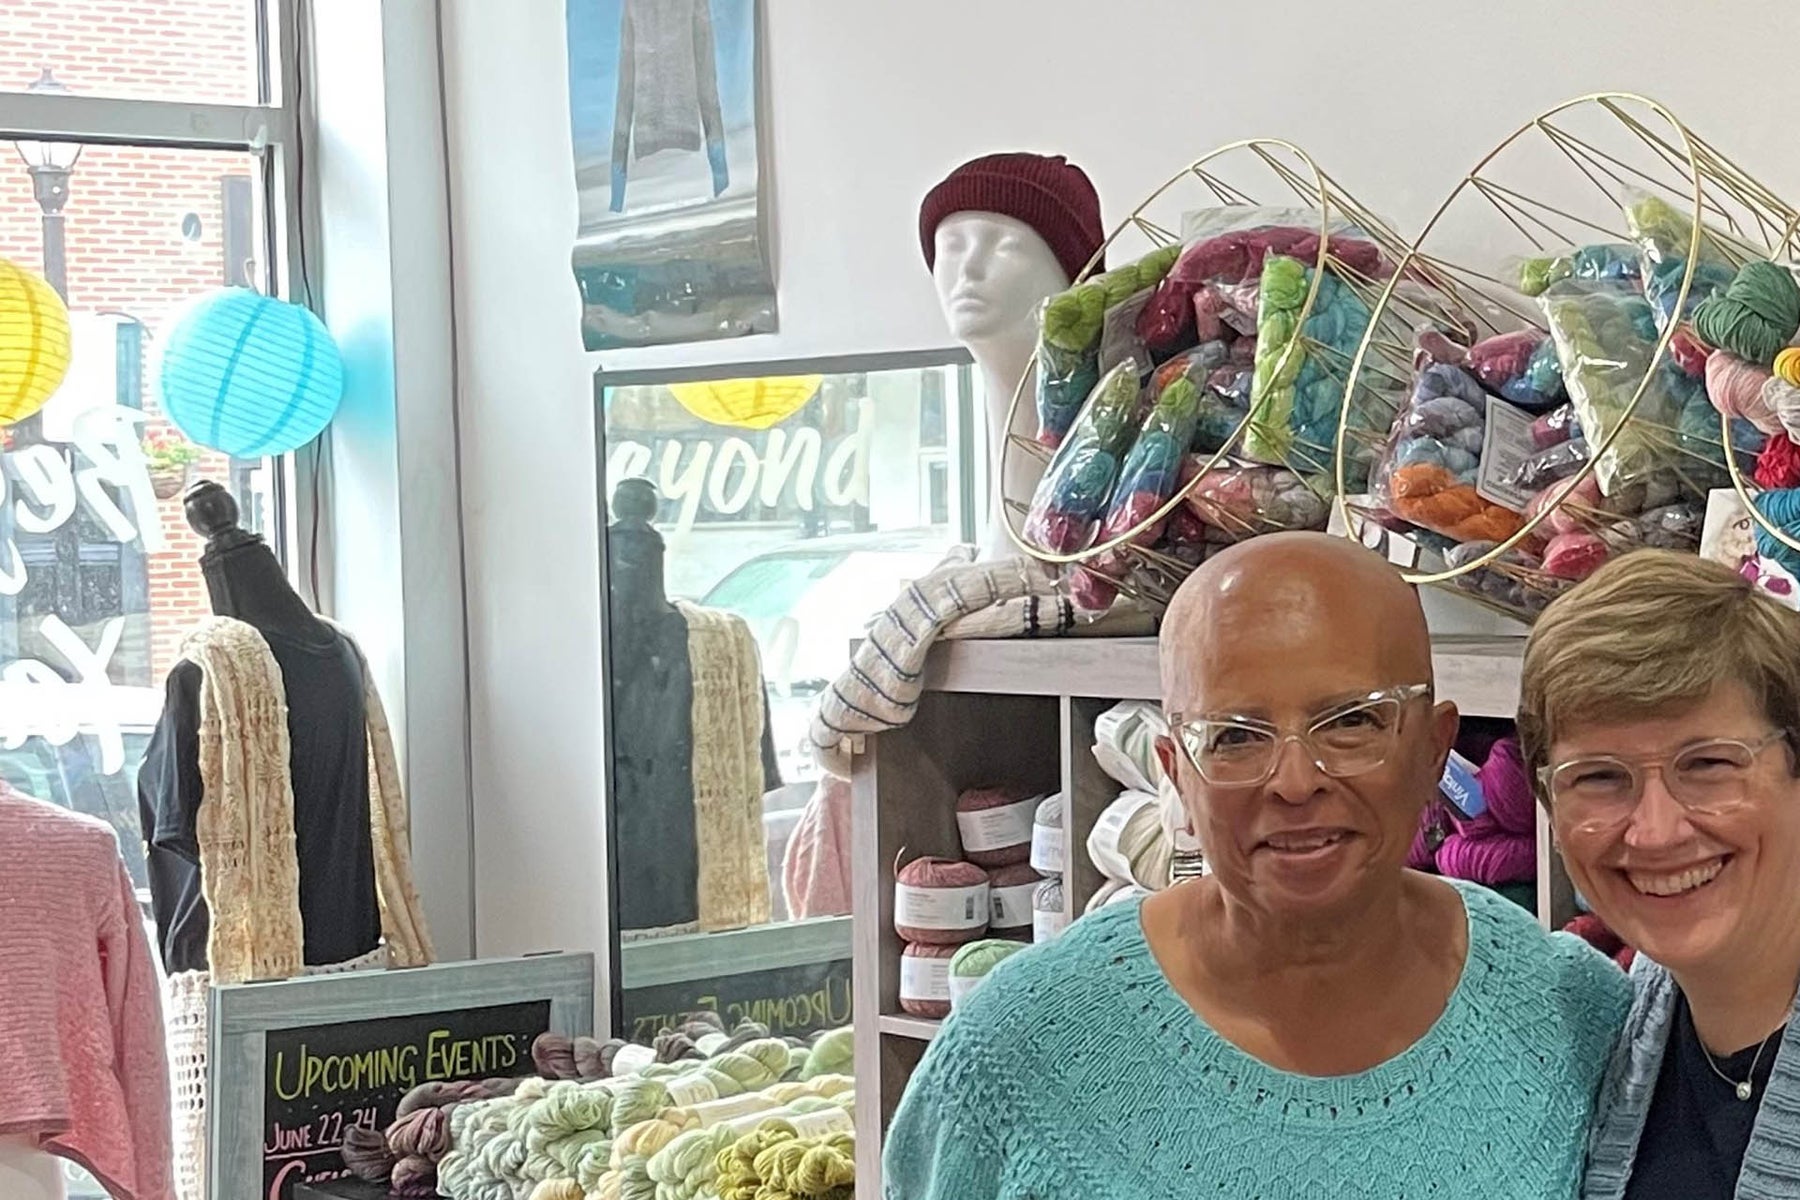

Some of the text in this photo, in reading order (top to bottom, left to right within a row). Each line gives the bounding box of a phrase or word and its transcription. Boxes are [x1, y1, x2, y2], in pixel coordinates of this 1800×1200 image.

[606, 397, 870, 548] eyond
[275, 1043, 418, 1100] UPCOMING
[264, 1122, 312, 1153] JUNE
